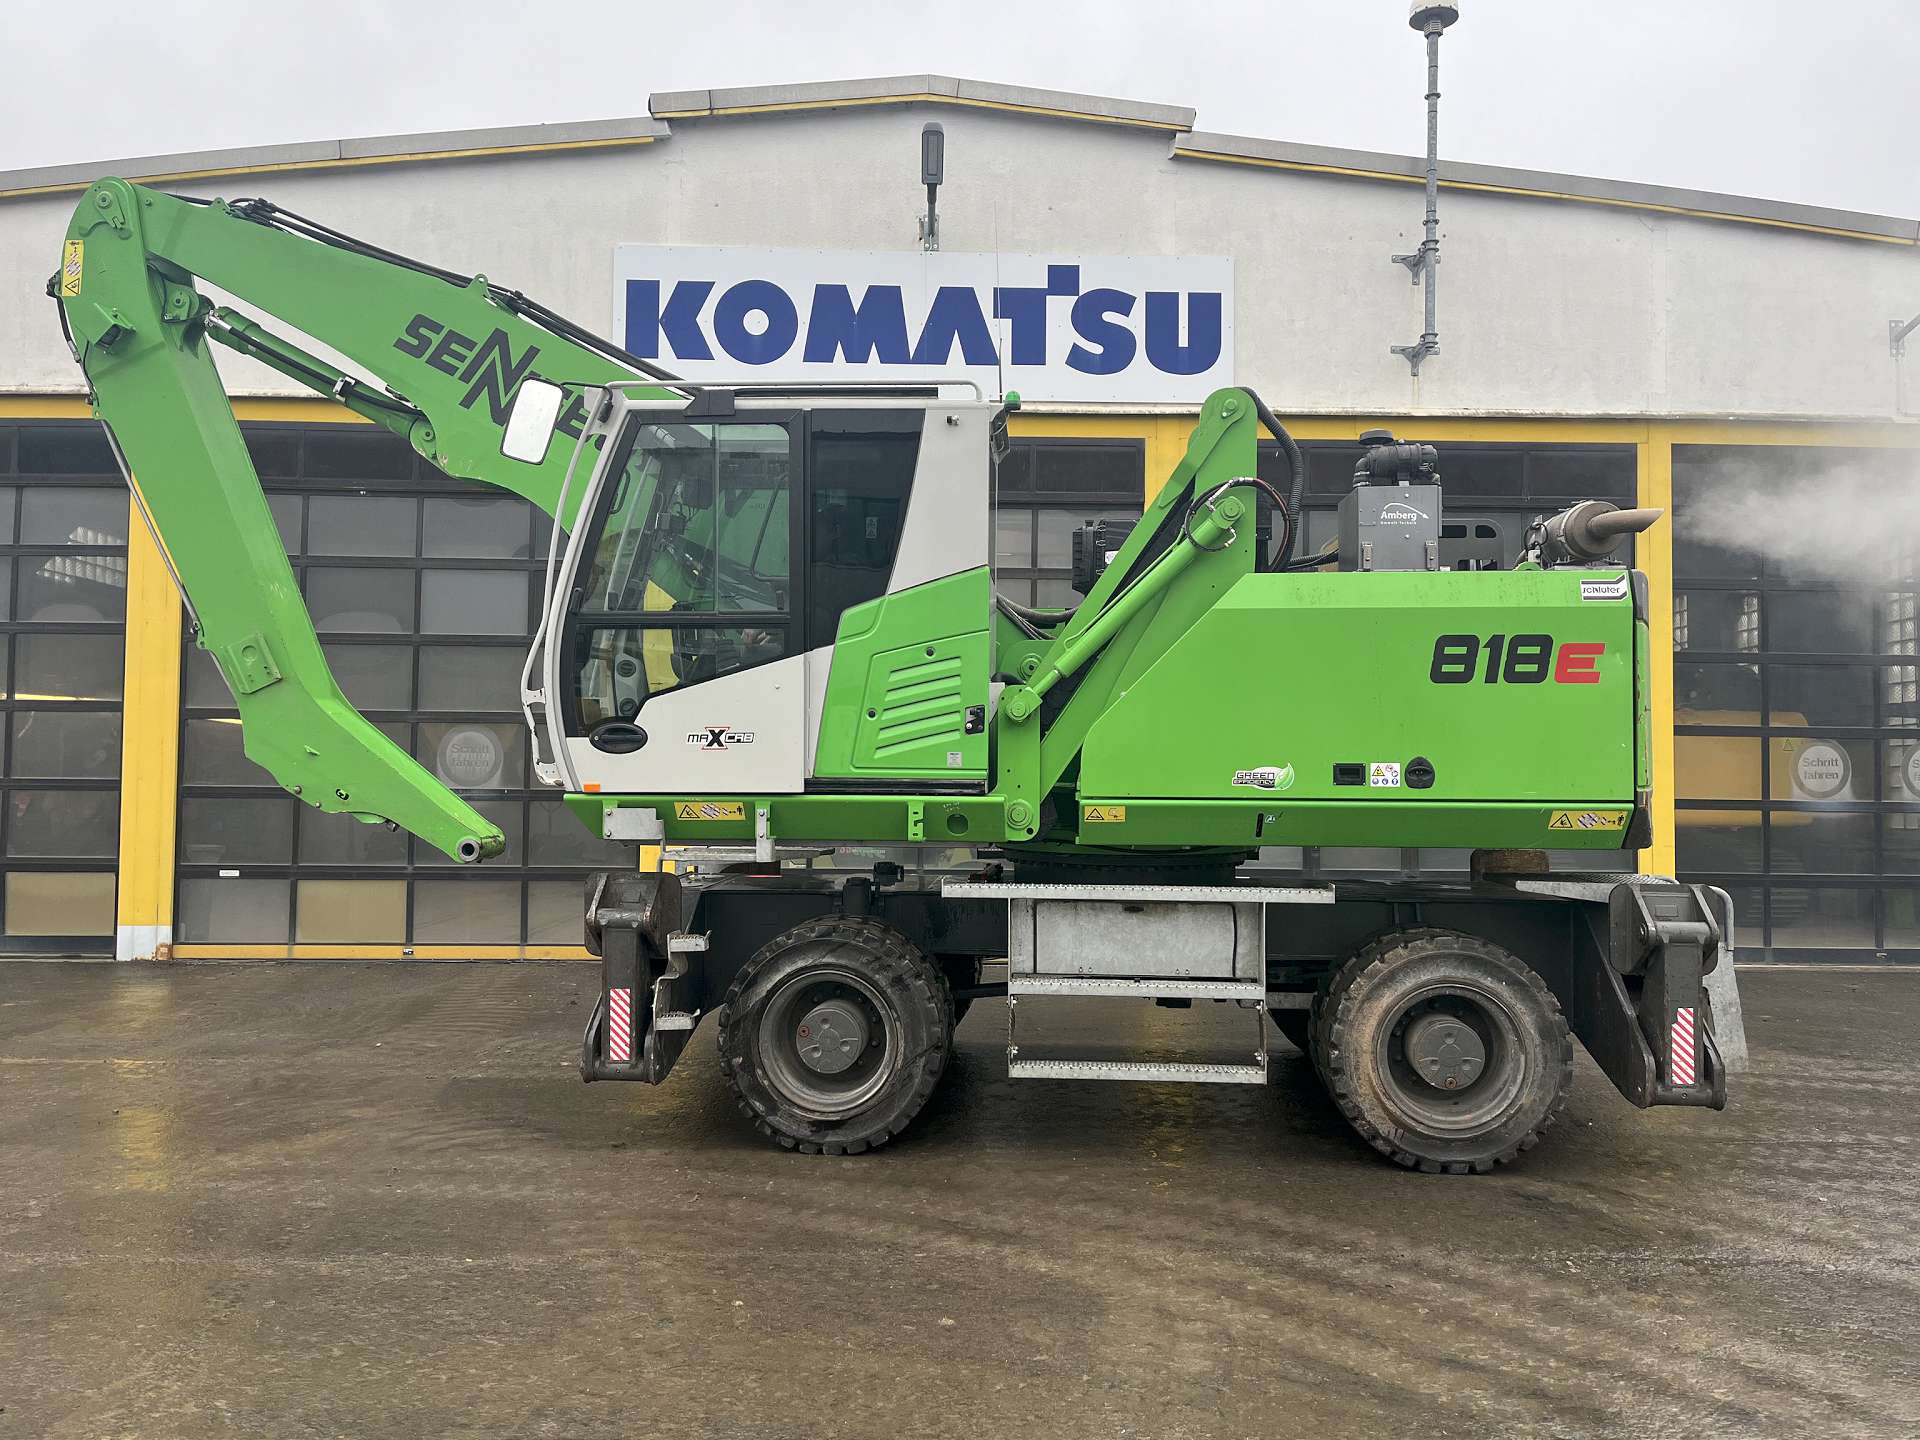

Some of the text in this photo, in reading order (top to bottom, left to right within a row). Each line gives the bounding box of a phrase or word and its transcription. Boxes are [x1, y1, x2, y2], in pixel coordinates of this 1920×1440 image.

[625, 264, 1222, 375] KOMATSU
[1380, 510, 1417, 521] Amberg
[1429, 634, 1606, 684] 818E
[1802, 757, 1839, 768] Schritt
